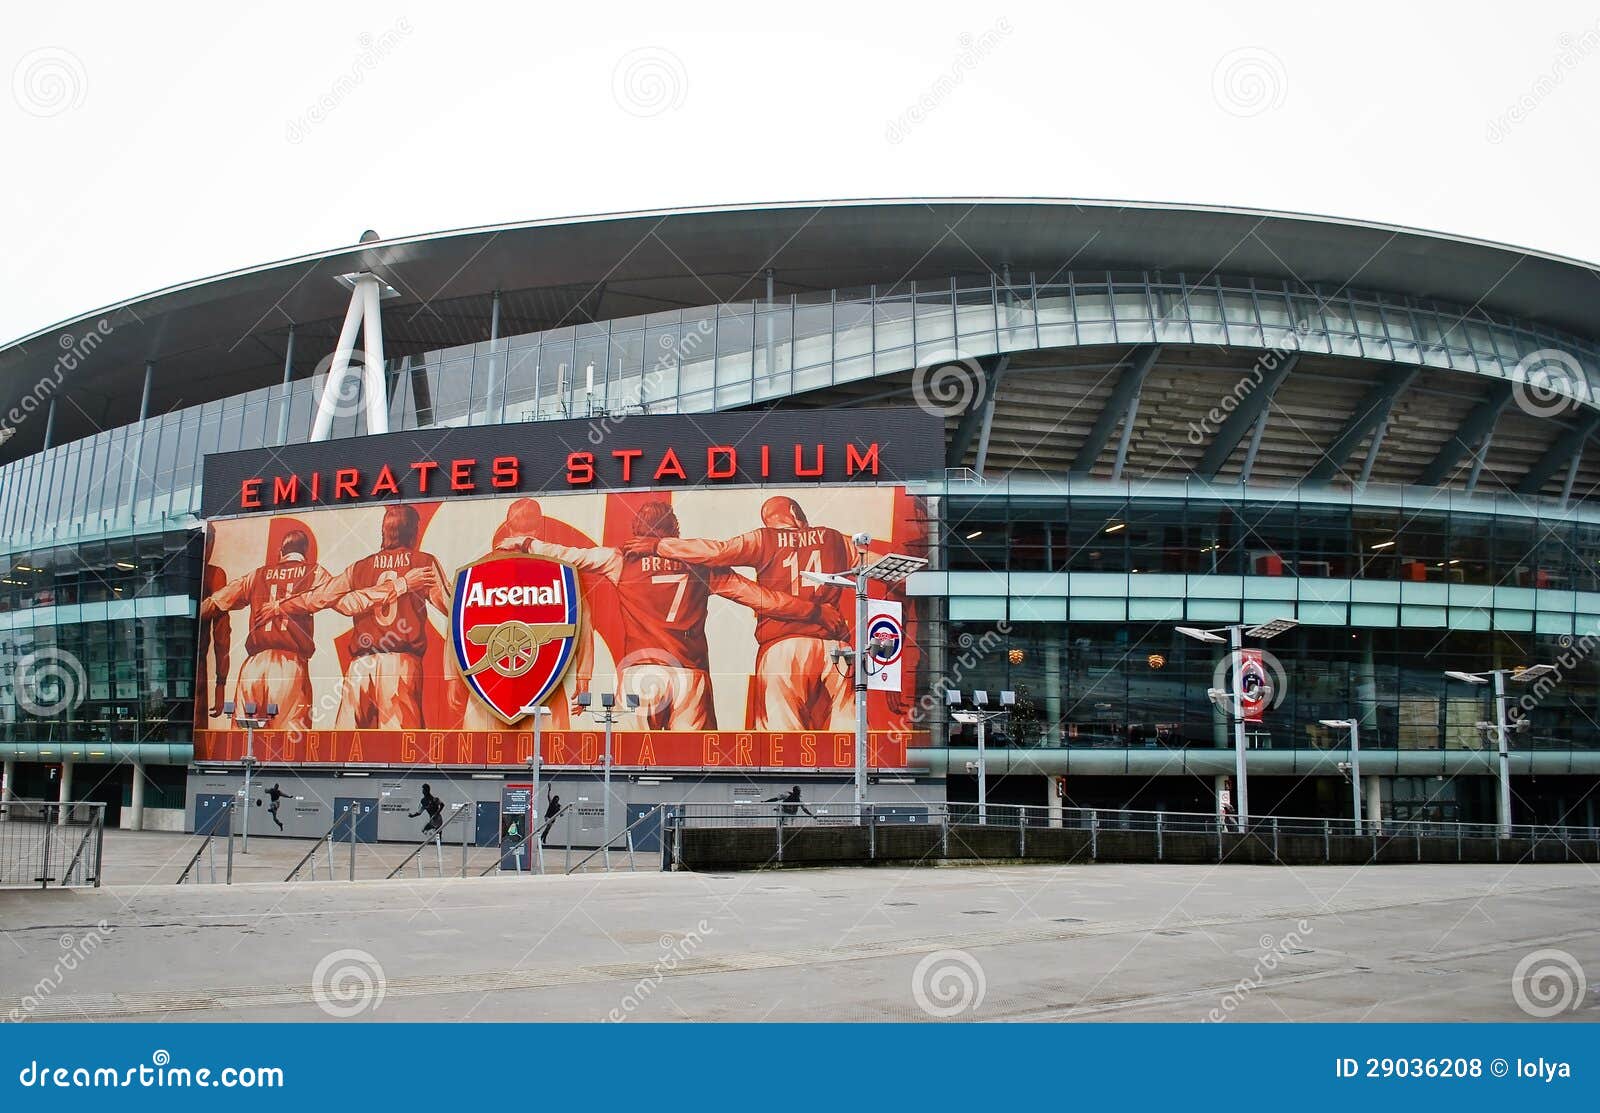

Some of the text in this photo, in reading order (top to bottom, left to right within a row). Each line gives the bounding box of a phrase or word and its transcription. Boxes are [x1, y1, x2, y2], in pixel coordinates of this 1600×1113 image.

[241, 443, 879, 508] EMIRATES STADIUM
[777, 530, 826, 547] HENRY
[266, 566, 306, 580] BASTIN
[373, 552, 411, 569] ADAMS
[783, 550, 822, 596] 14
[466, 579, 562, 607] Arsenal
[652, 573, 689, 622] 7
[401, 733, 656, 766] CONCORDIA
[703, 733, 913, 767] CRESCIT
